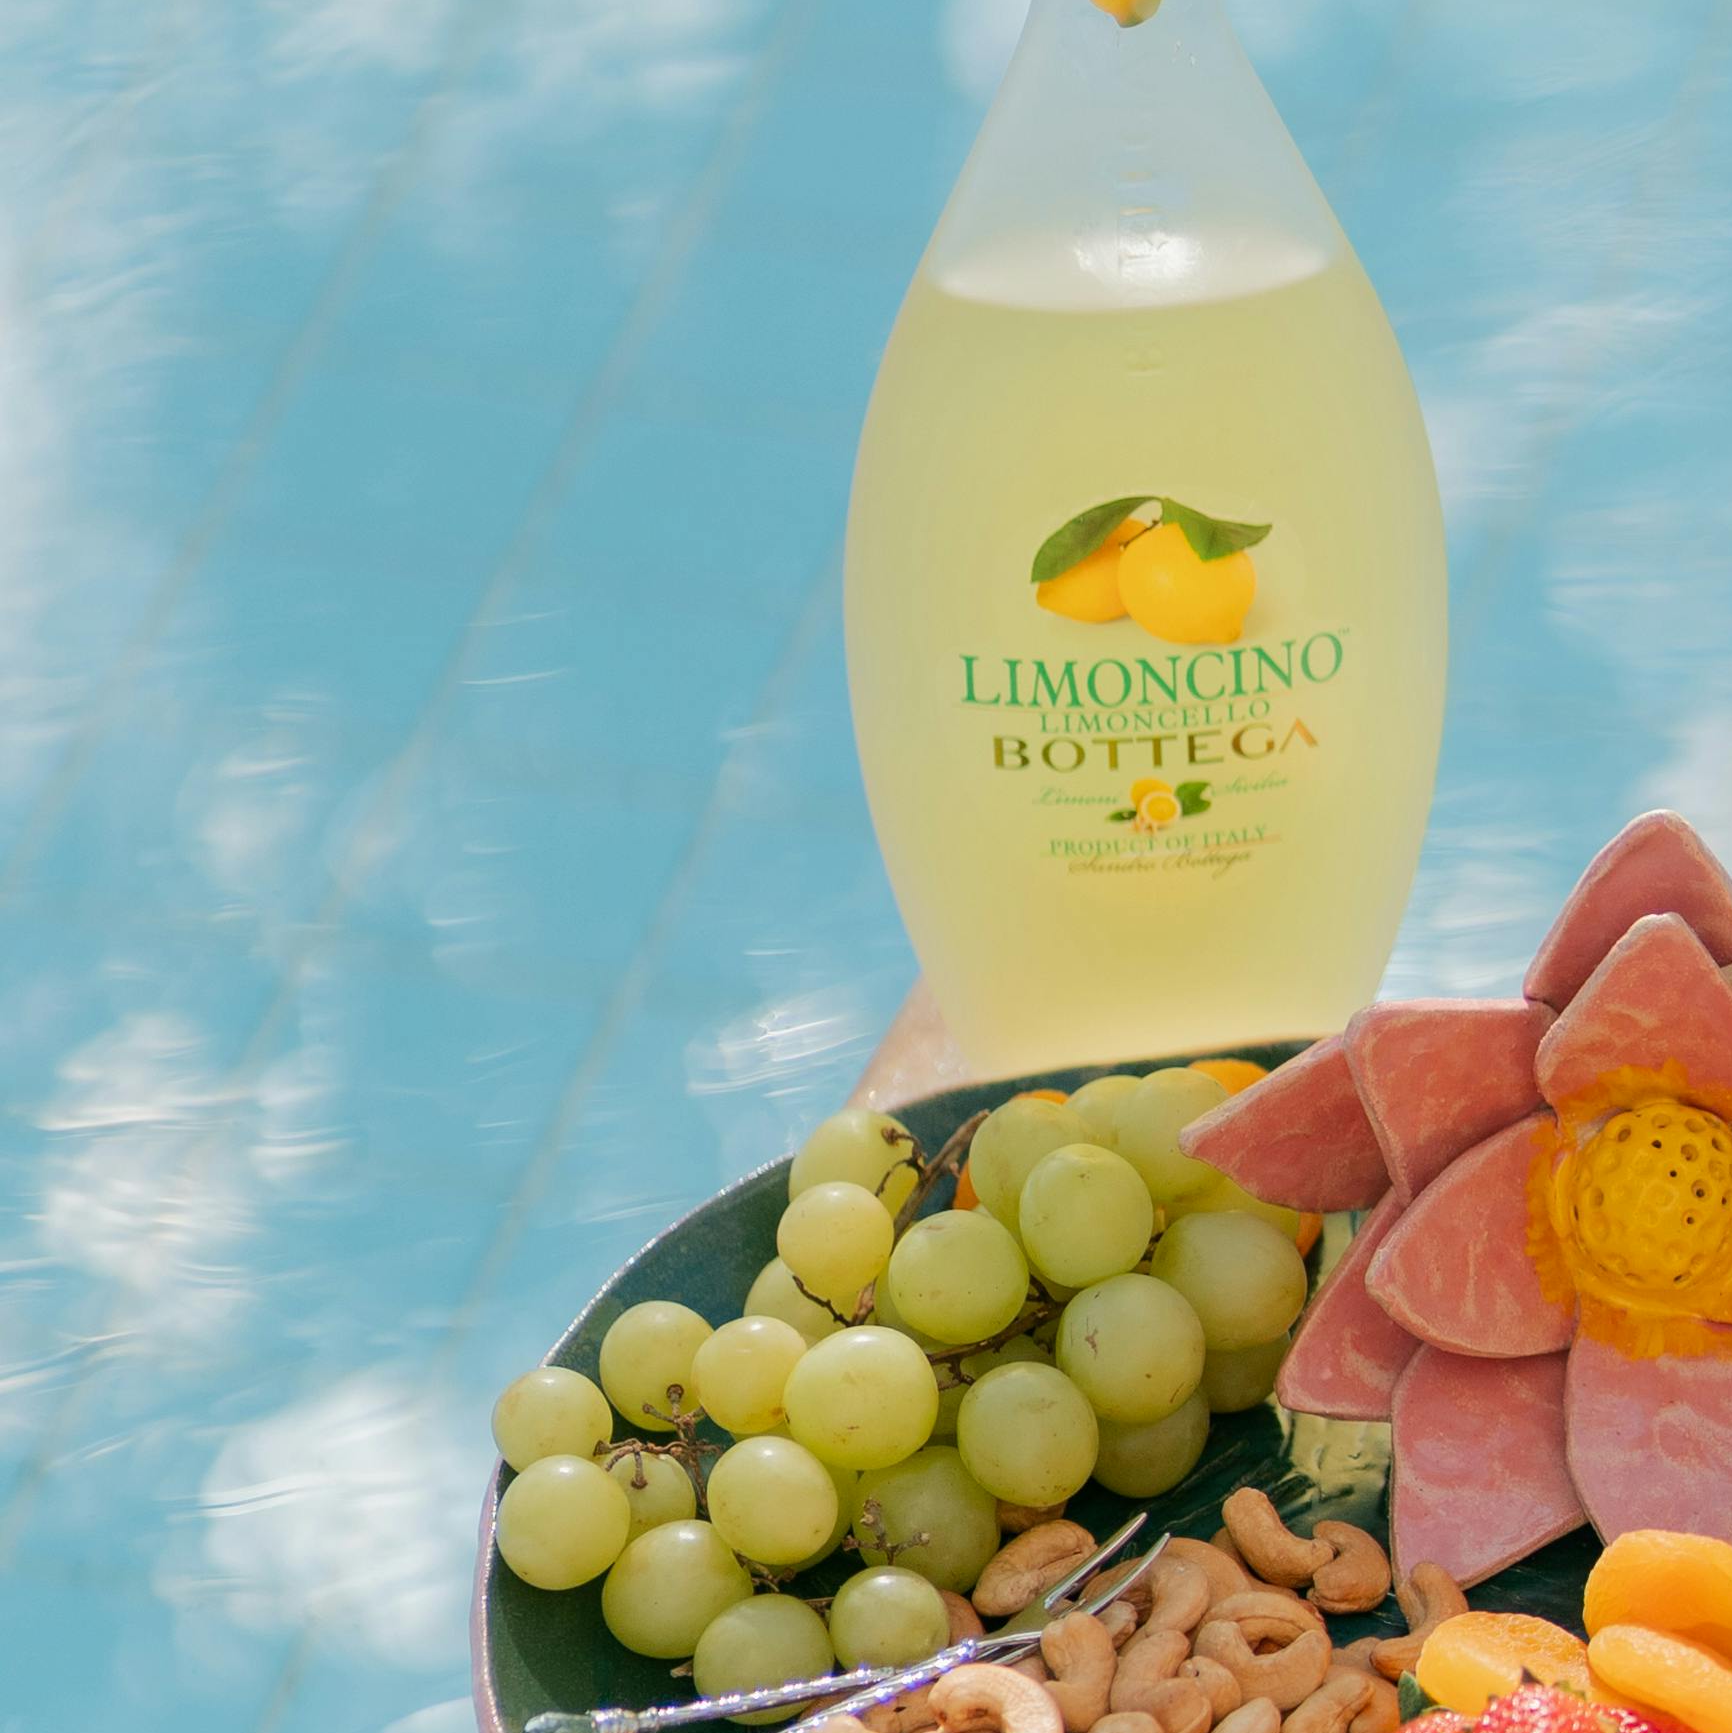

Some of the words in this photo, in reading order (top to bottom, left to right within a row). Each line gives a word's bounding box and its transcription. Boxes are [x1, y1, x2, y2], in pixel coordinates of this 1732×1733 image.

[958, 631, 1343, 709] LIMONCINO
[1040, 699, 1271, 734] LIMONCELLO
[993, 717, 1319, 774] BOTTEGA
[1049, 836, 1158, 857] PRODUCT
[1165, 834, 1196, 852] OF
[1203, 822, 1268, 850] ITALY
